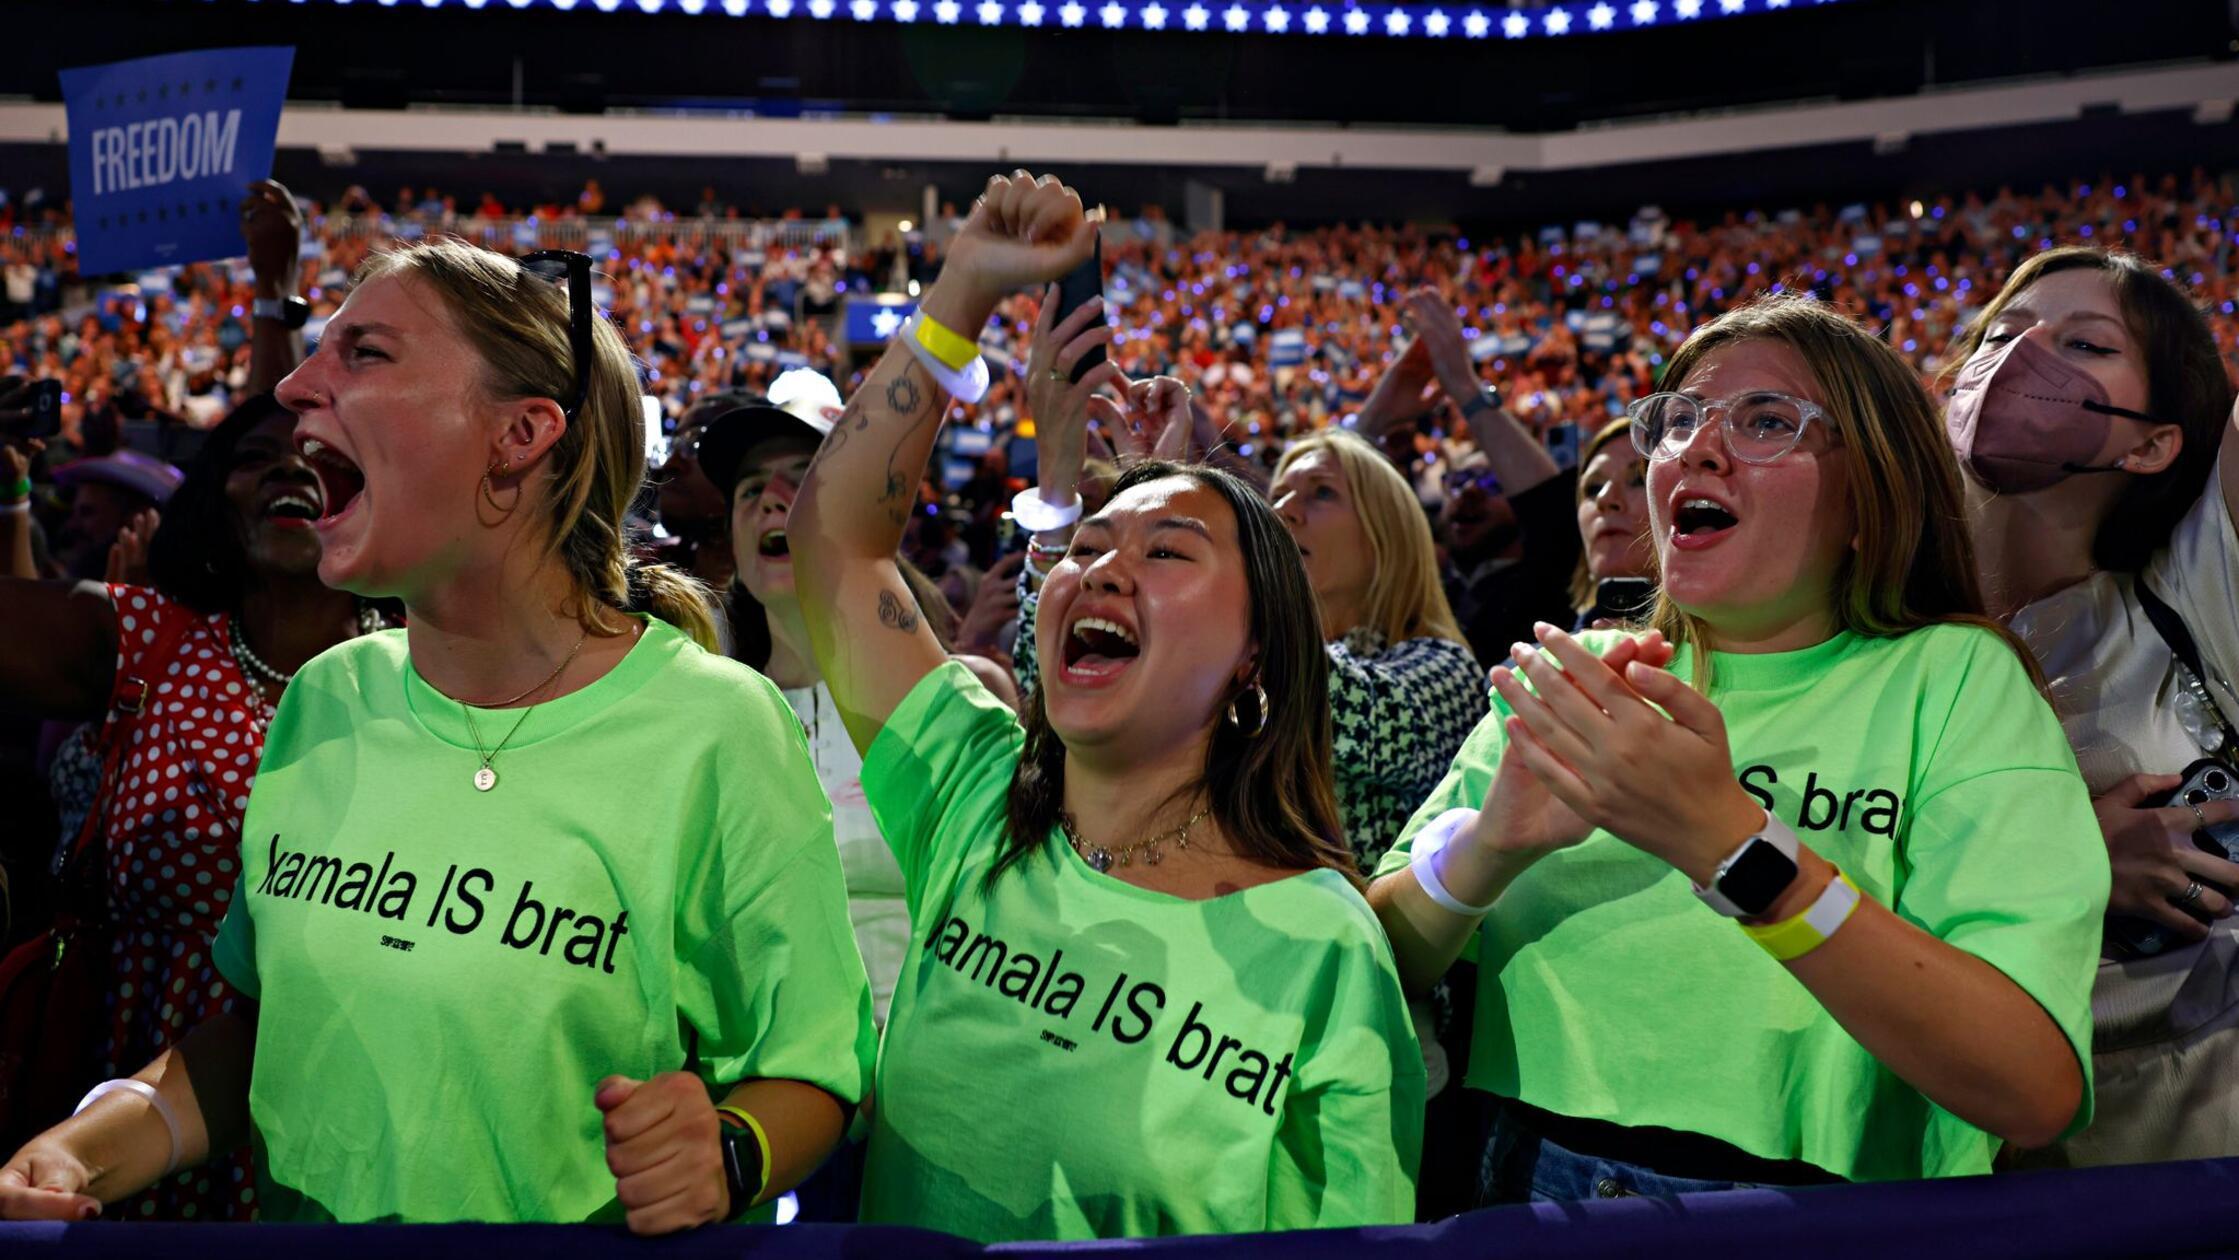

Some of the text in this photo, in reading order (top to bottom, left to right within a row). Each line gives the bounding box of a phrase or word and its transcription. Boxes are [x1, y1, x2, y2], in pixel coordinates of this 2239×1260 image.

[92, 108, 242, 195] FREEDOM
[1738, 765, 1906, 840] S bra
[257, 834, 629, 975] kamala IS brat
[1091, 972, 1167, 1045] IS
[1165, 1001, 1294, 1117] brat
